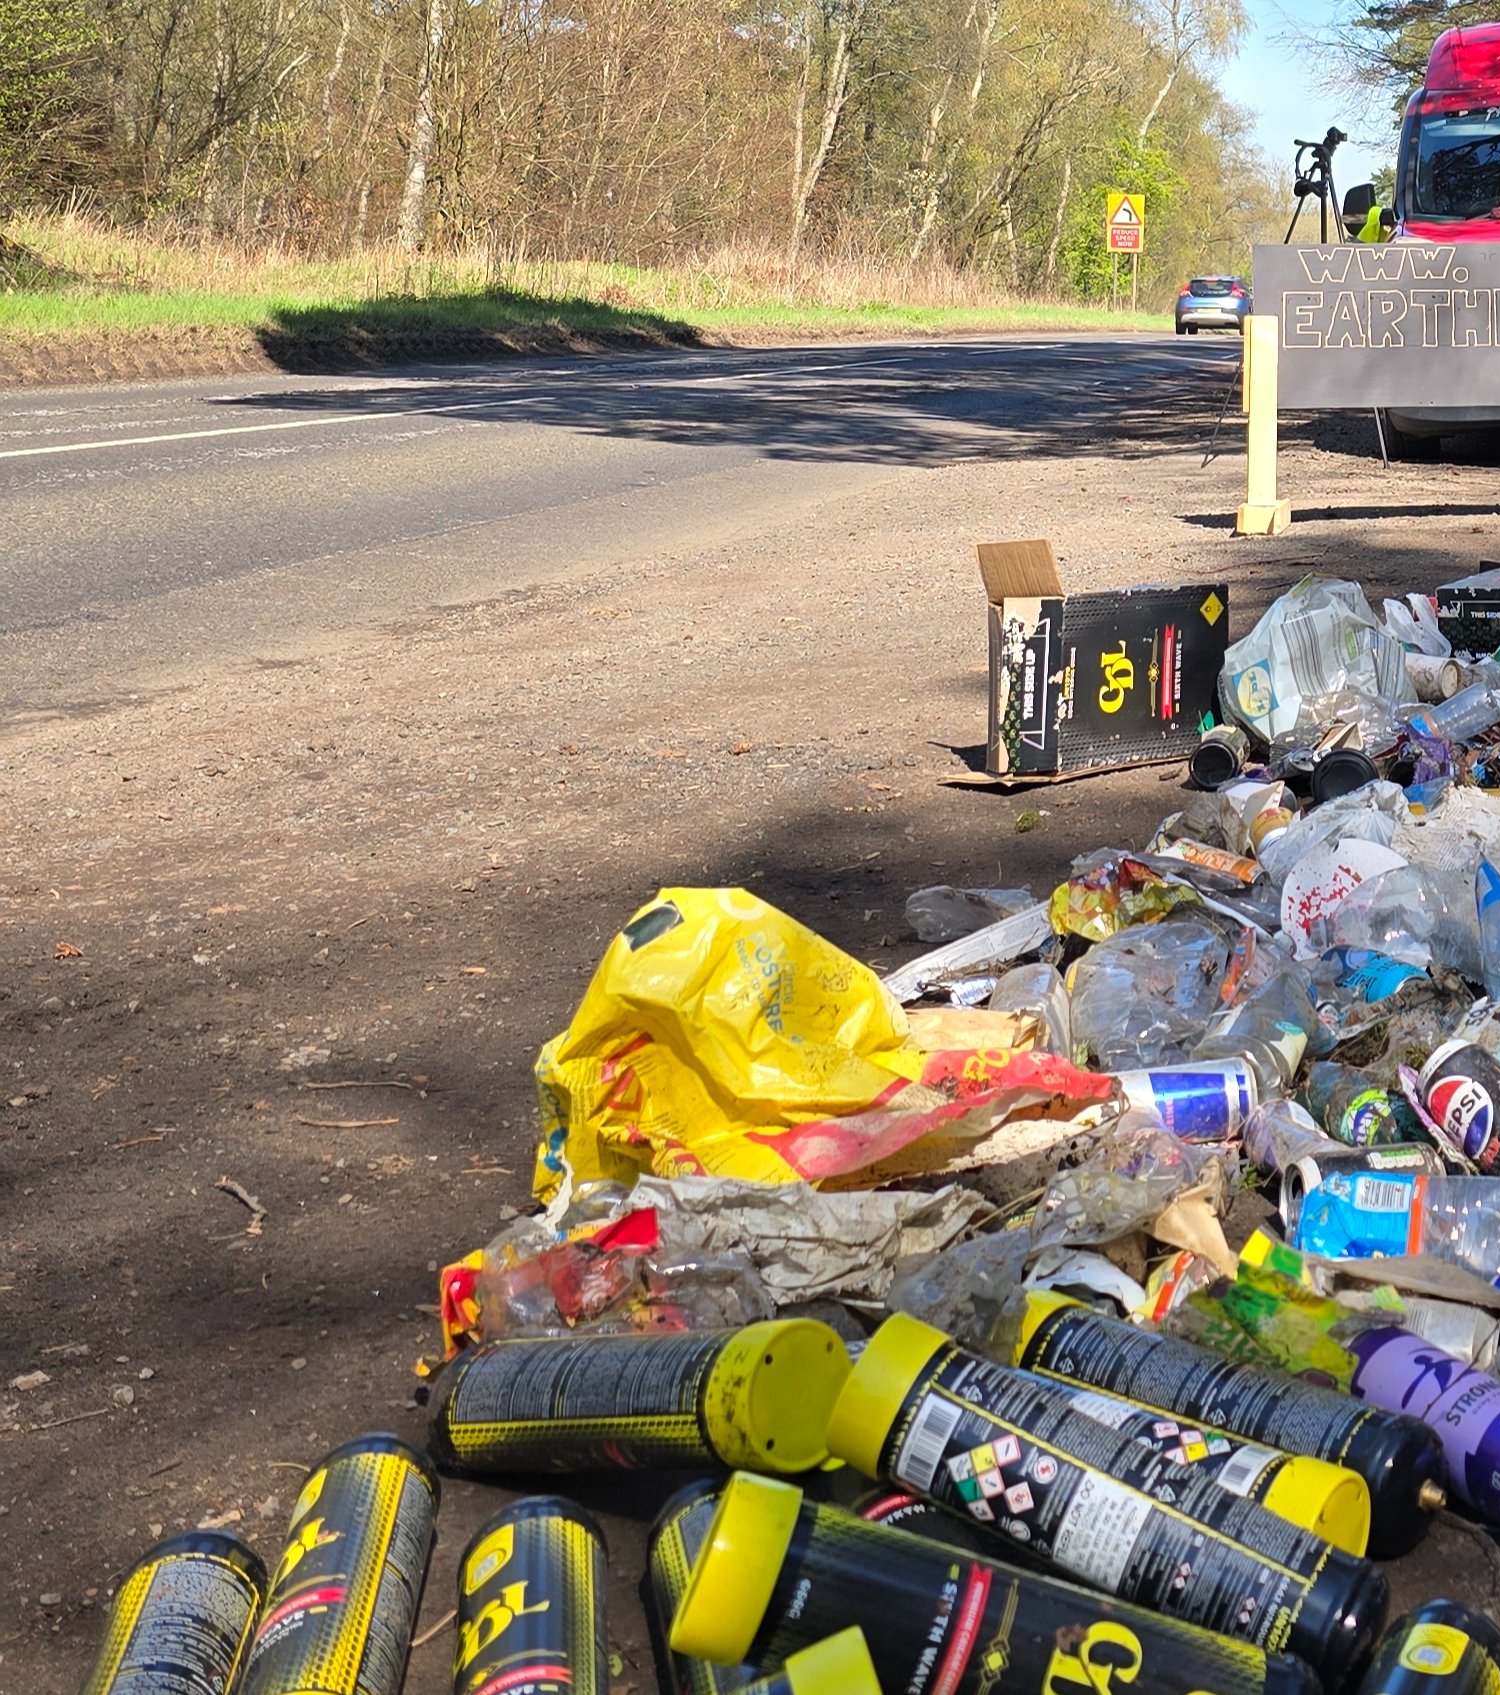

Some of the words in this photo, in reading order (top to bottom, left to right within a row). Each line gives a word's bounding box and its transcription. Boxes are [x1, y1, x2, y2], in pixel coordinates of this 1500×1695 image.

[1297, 247, 1469, 284] WWW.
[1470, 610, 1486, 619] THIS
[1486, 611, 1500, 619] SIDE
[1025, 649, 1036, 665] UP
[1024, 666, 1035, 692] SIDE
[1023, 693, 1034, 720] THIS
